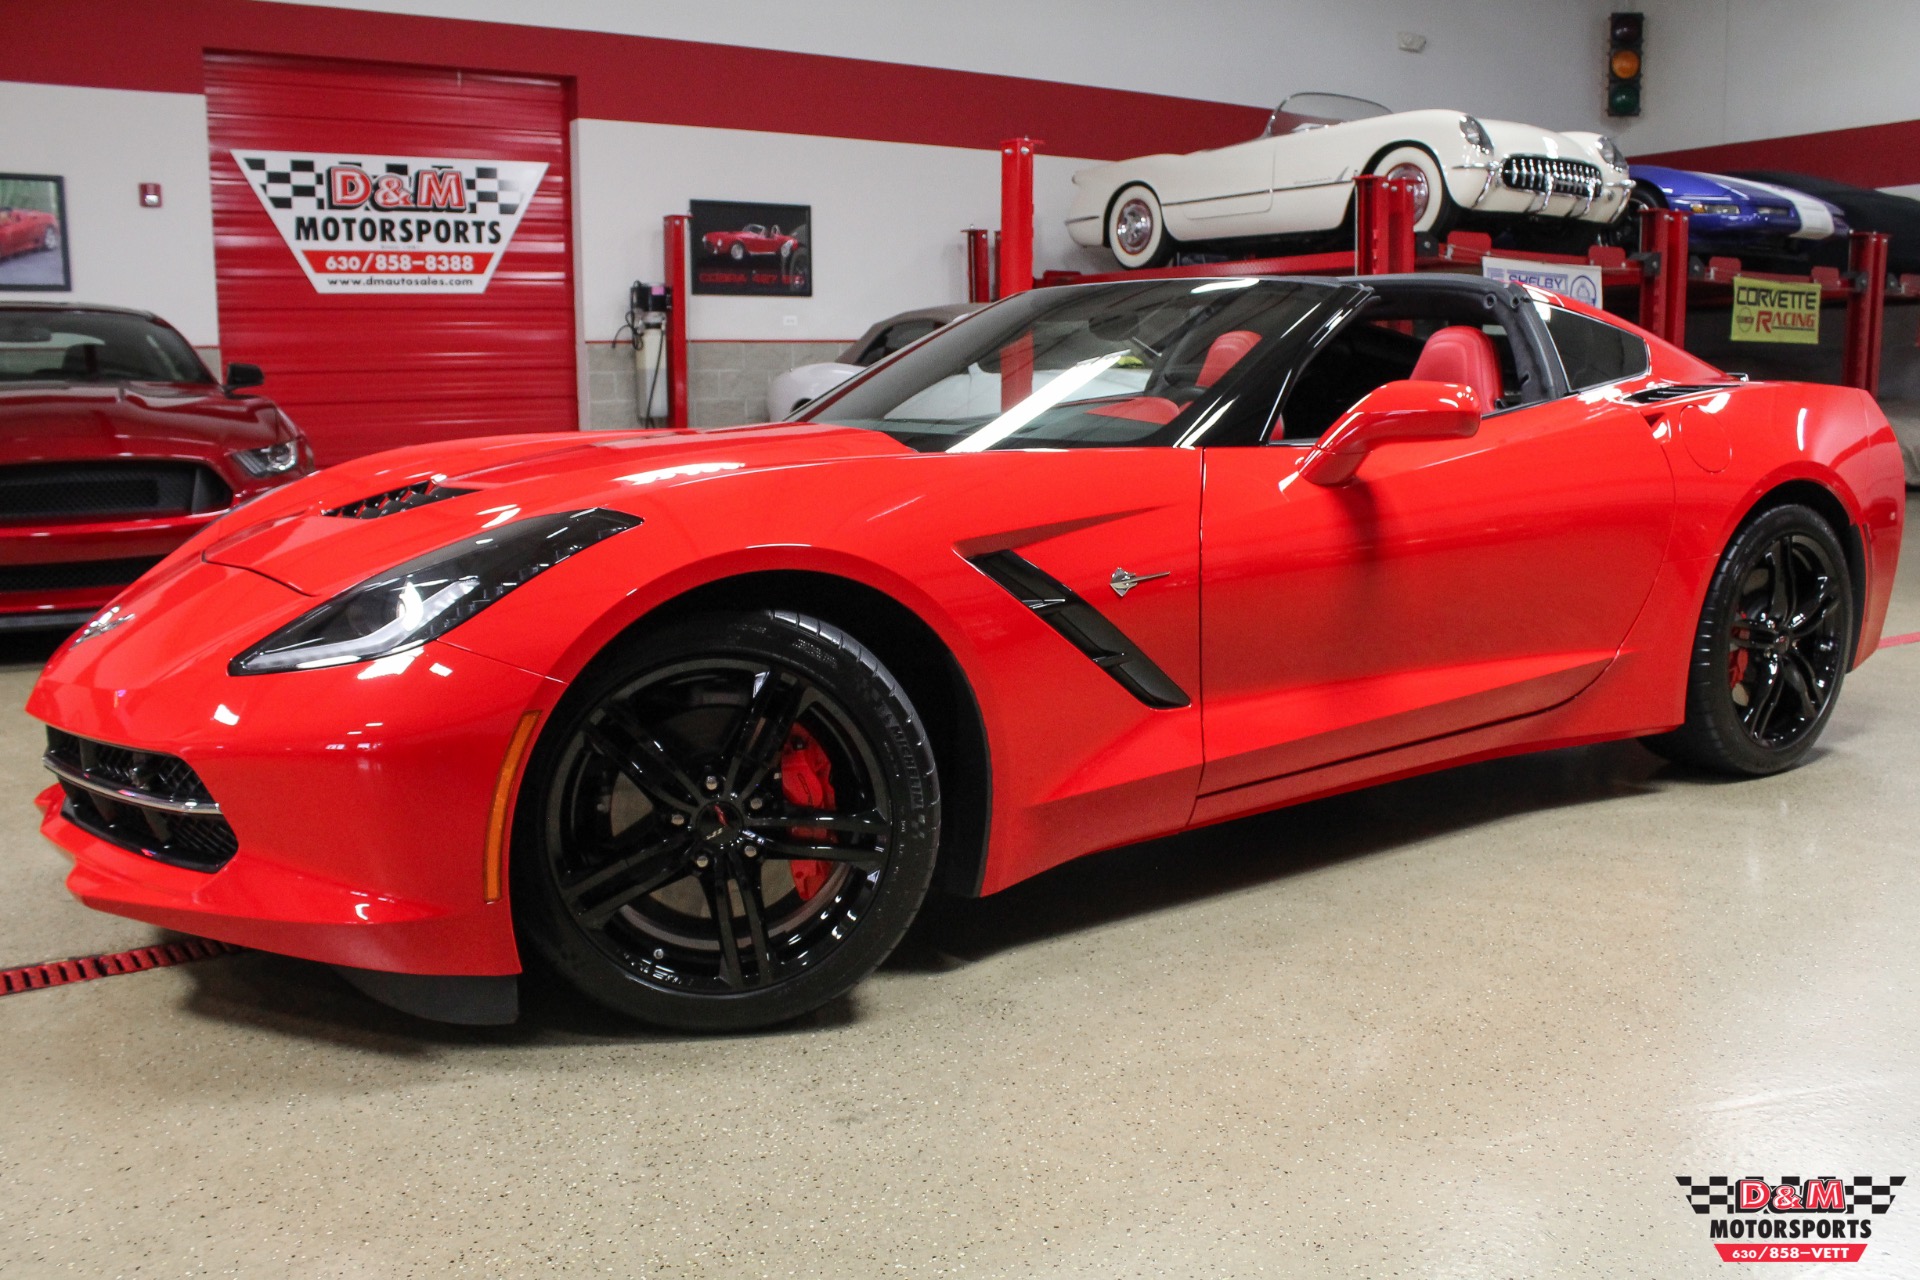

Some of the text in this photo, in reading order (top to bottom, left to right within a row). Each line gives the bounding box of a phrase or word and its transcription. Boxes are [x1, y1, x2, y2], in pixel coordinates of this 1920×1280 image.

[328, 166, 466, 211] D&M
[295, 216, 501, 244] MOTORSPORTS
[325, 253, 474, 272] 630/858-8388
[327, 276, 473, 287] www.dmautosales.com
[1508, 274, 1563, 289] SHELBY
[1737, 286, 1817, 310] CORVETTE
[1756, 310, 1816, 334] RACING
